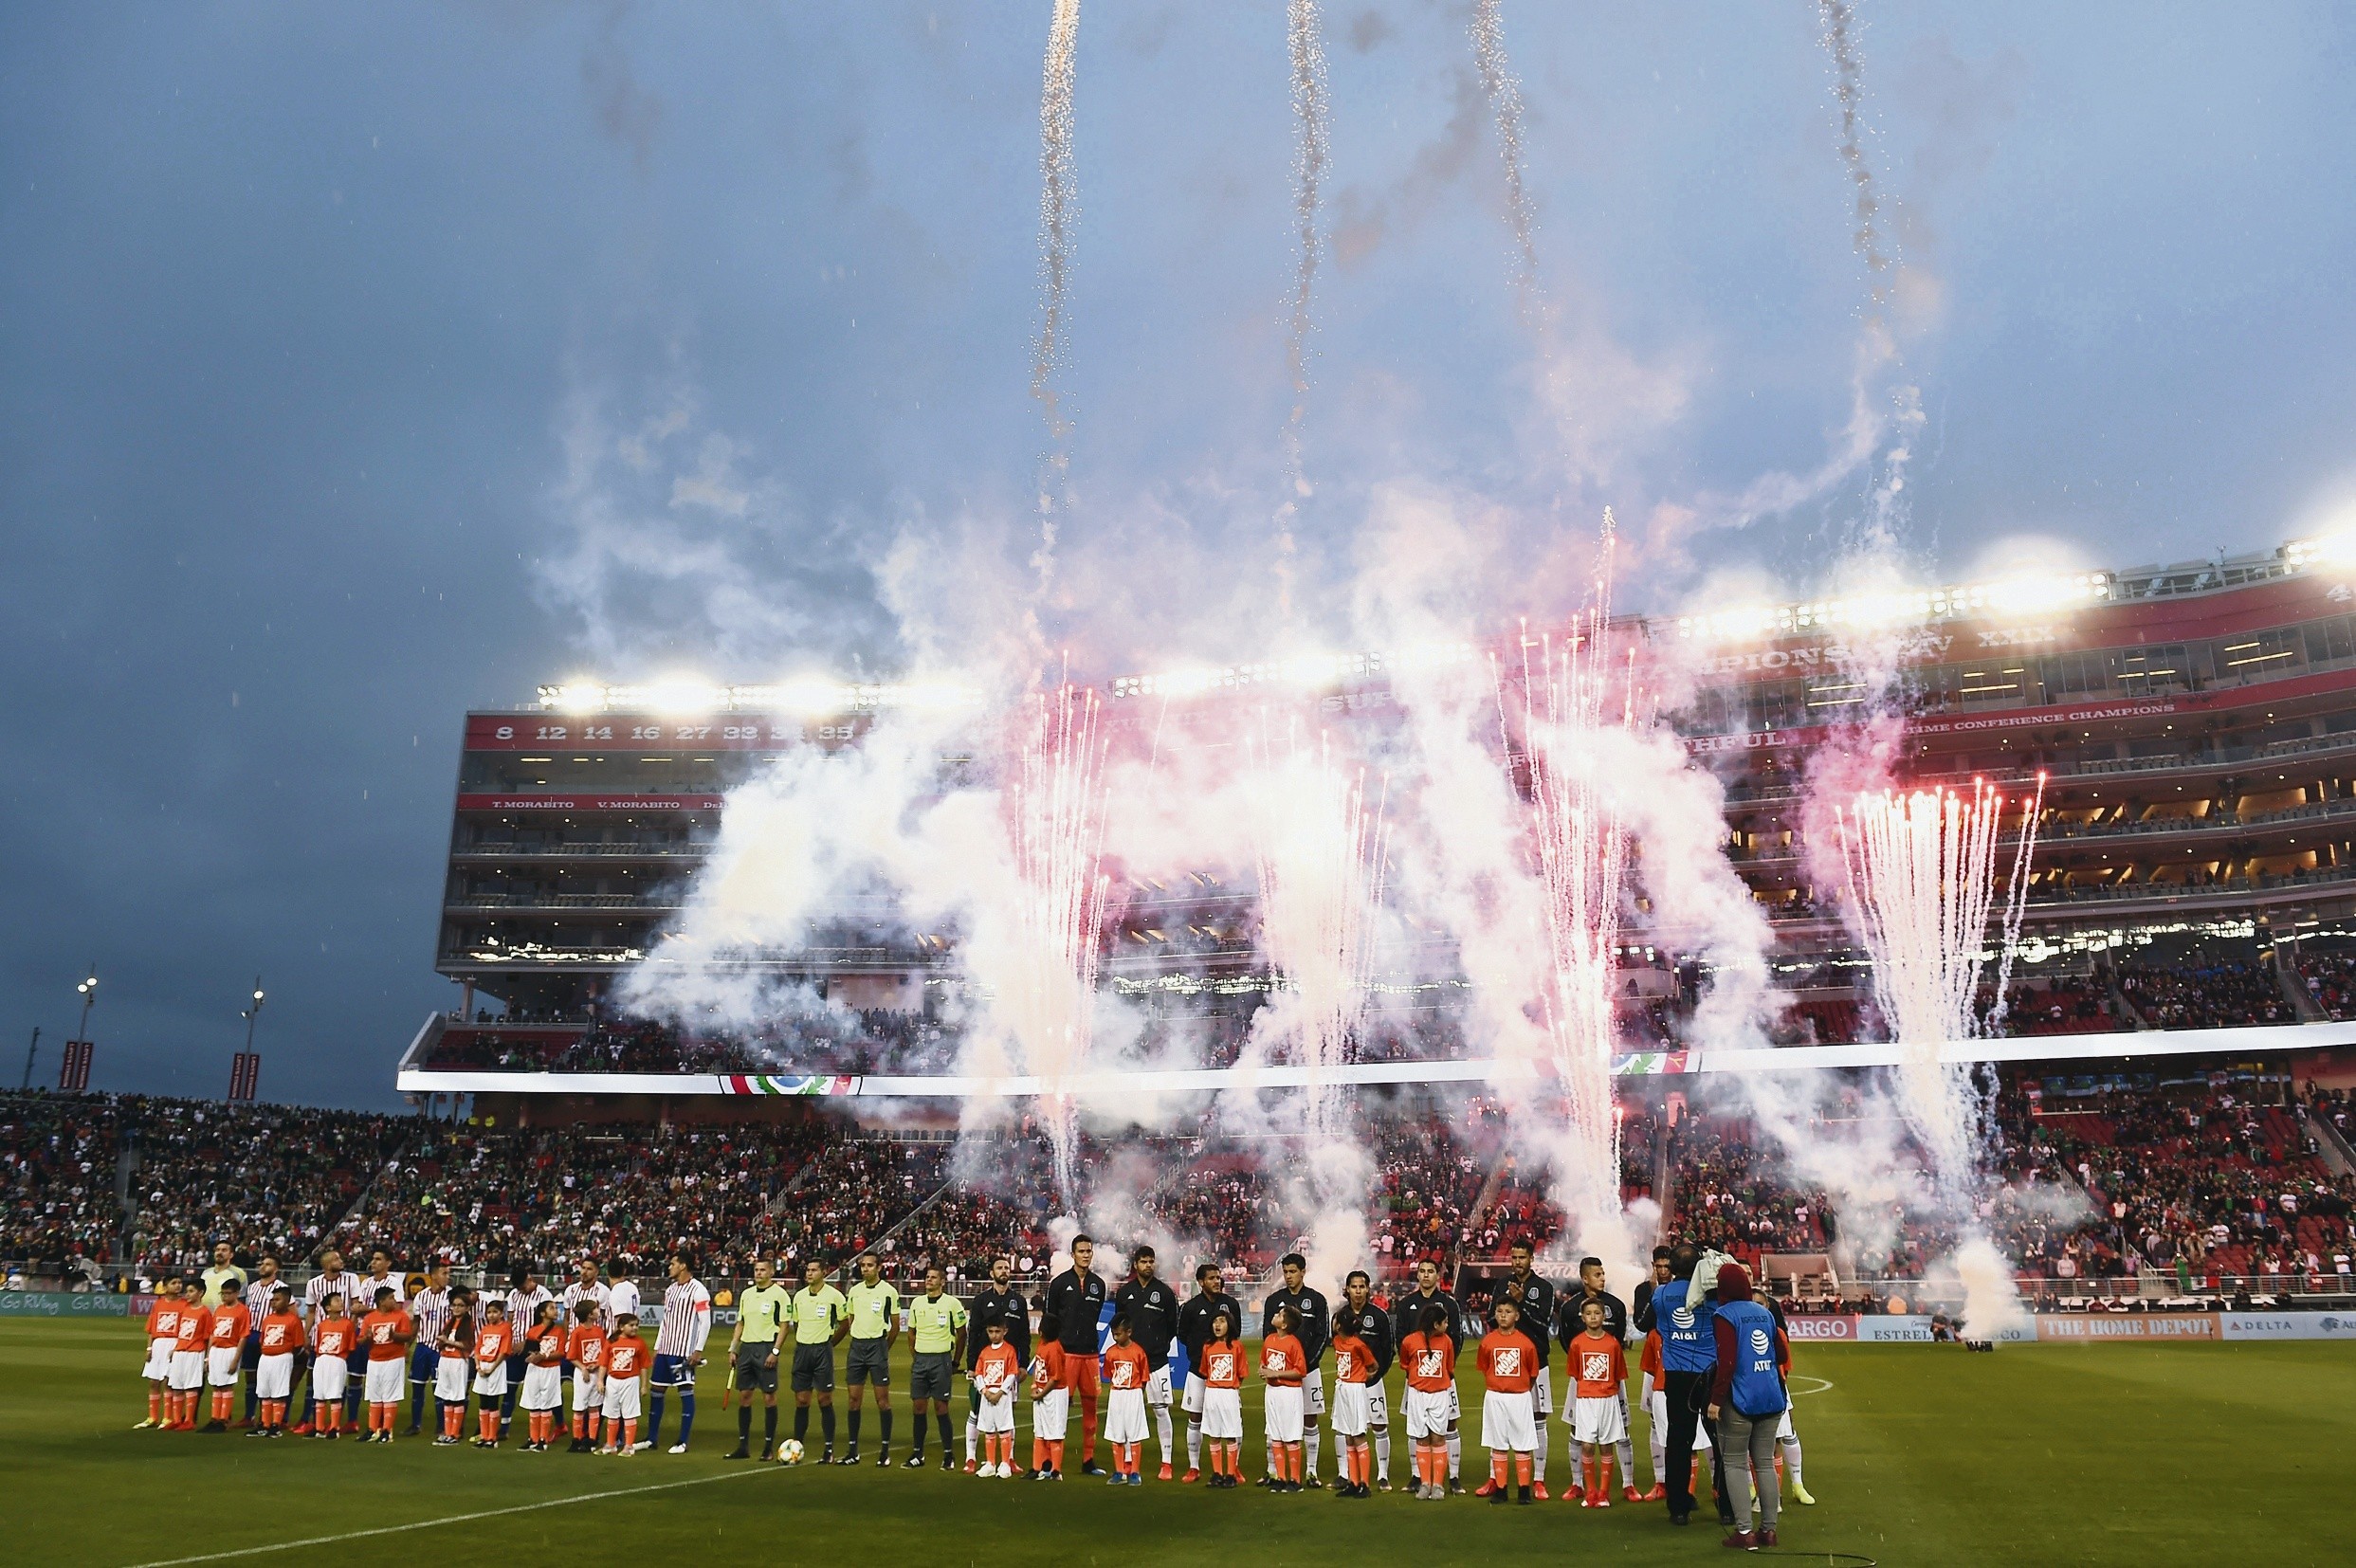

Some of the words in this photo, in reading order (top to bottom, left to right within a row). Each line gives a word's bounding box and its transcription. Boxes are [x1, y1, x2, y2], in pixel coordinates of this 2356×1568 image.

[1705, 645, 1852, 675] PIONS
[1954, 714, 2064, 730] CONFERENCE
[2069, 703, 2175, 720] CHAMPIONS
[495, 726, 514, 739] 8
[536, 726, 567, 739] 12
[583, 726, 612, 739] 14
[630, 726, 660, 739] 16
[676, 726, 711, 739] 27
[818, 726, 854, 739] 35
[1786, 1320, 1848, 1338] ARGO
[2044, 1320, 2085, 1336] THE
[2090, 1319, 2144, 1336] HOME
[2148, 1319, 2213, 1336] DEPOT
[2244, 1321, 2292, 1330] DELTA
[1671, 1331, 1697, 1340] AT&T
[1874, 1329, 1931, 1340] ESTREL
[1753, 1359, 1771, 1373] AT&T
[1160, 1377, 1169, 1393] 2
[1369, 1396, 1385, 1413] 29
